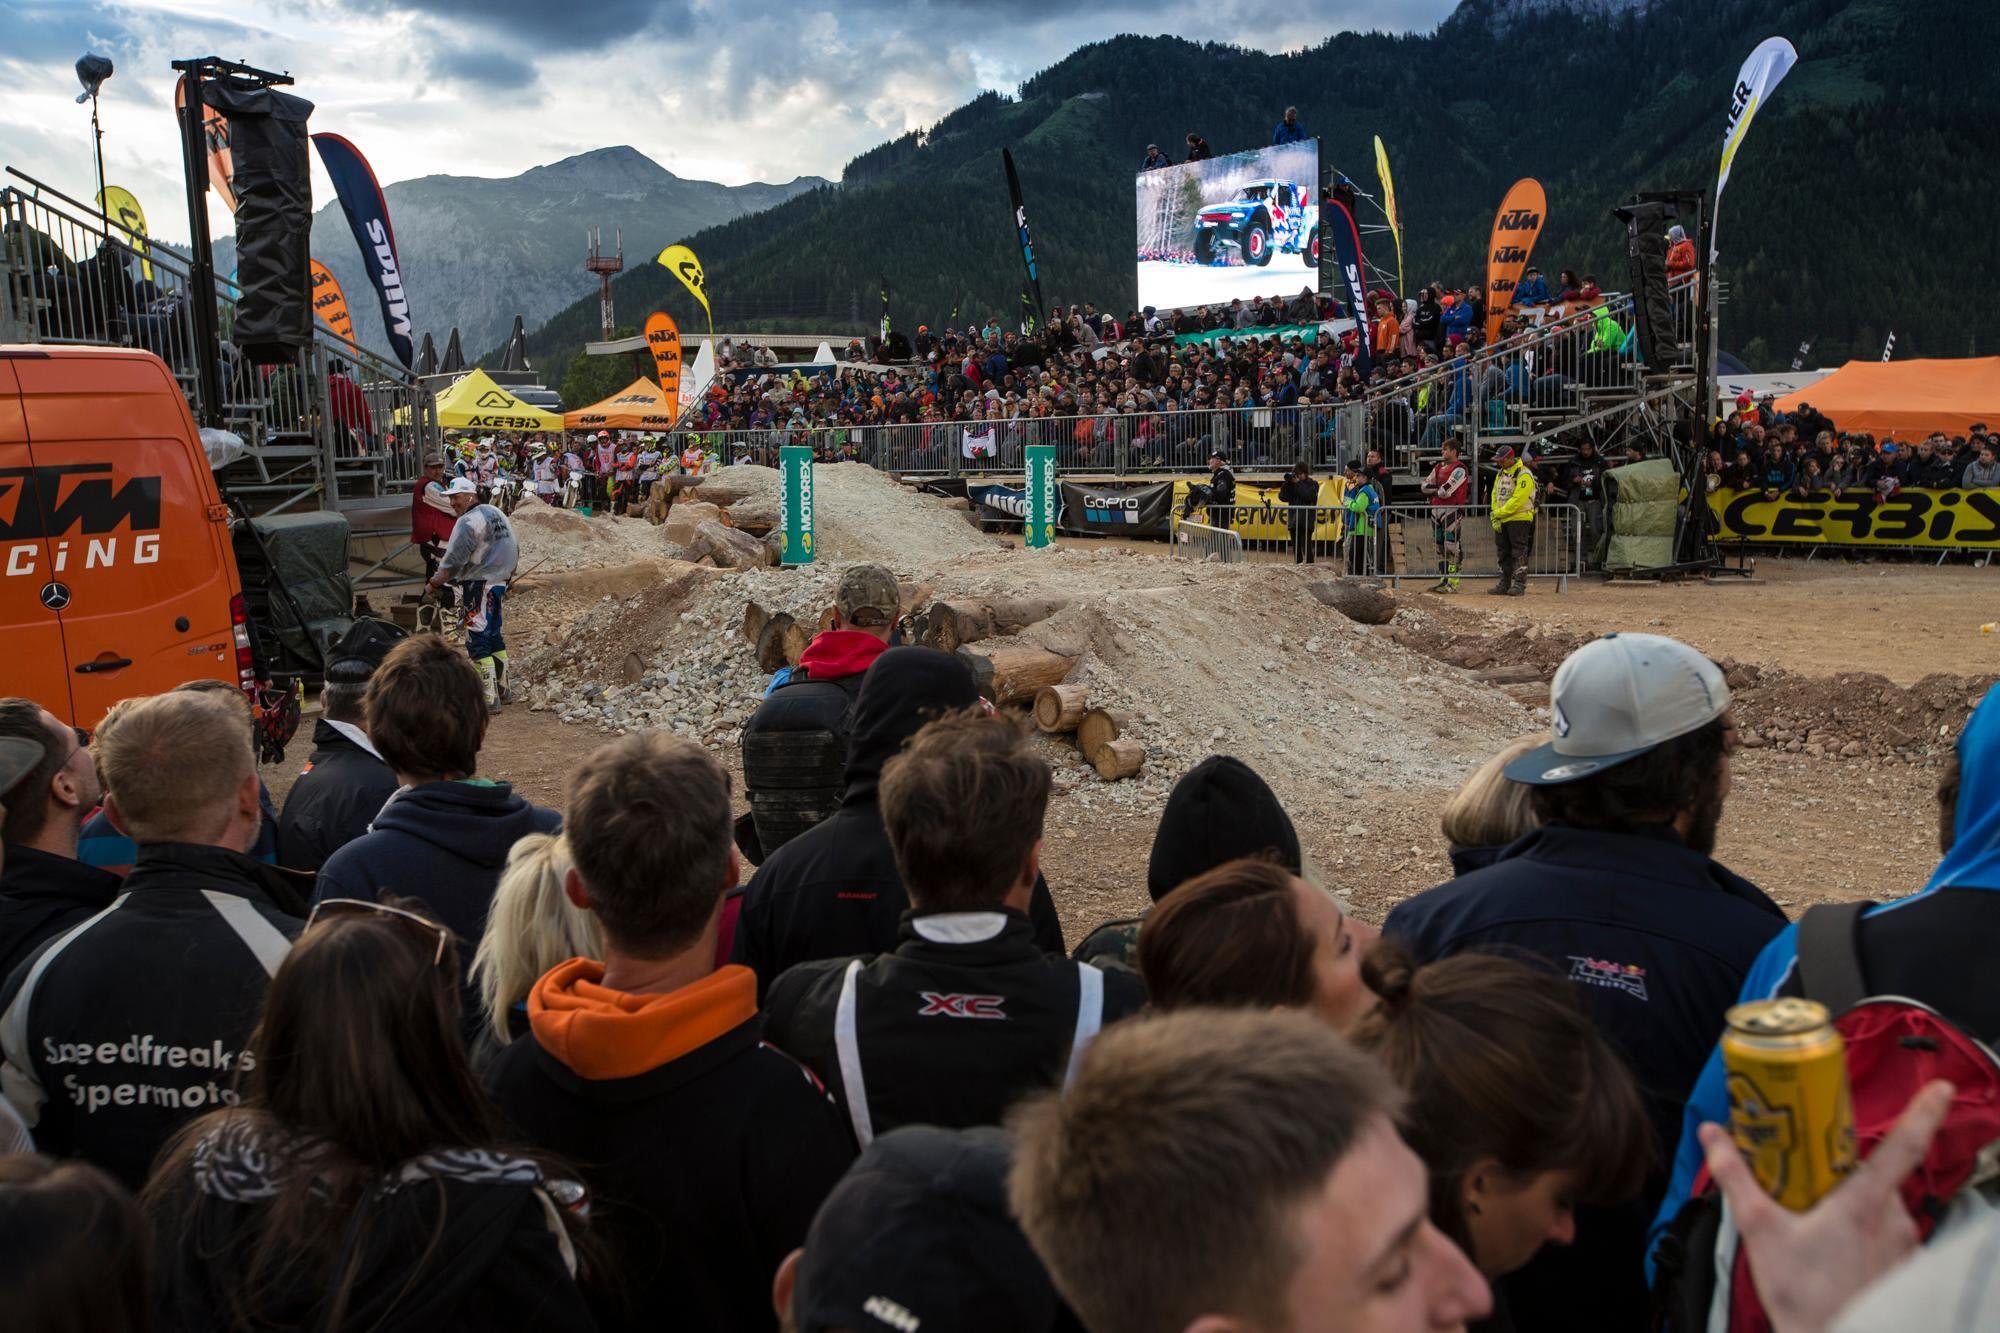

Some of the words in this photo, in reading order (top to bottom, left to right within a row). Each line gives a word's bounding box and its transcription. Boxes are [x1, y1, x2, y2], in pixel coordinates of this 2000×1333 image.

[1498, 209, 1540, 231] KTM
[1493, 246, 1527, 264] KTM
[366, 218, 414, 347] Mitas
[1490, 279, 1516, 292] KTM
[1881, 331, 1896, 363] OTT
[0, 463, 162, 541] TM
[780, 458, 789, 532] MOTOREX
[800, 457, 812, 532] MOTOREX
[985, 493, 1026, 517] Mita
[1025, 457, 1034, 524] MOTOREX
[1044, 456, 1054, 524] MOTOREX
[917, 990, 1008, 1020] XC
[43, 1034, 257, 1072] Speedfreaks
